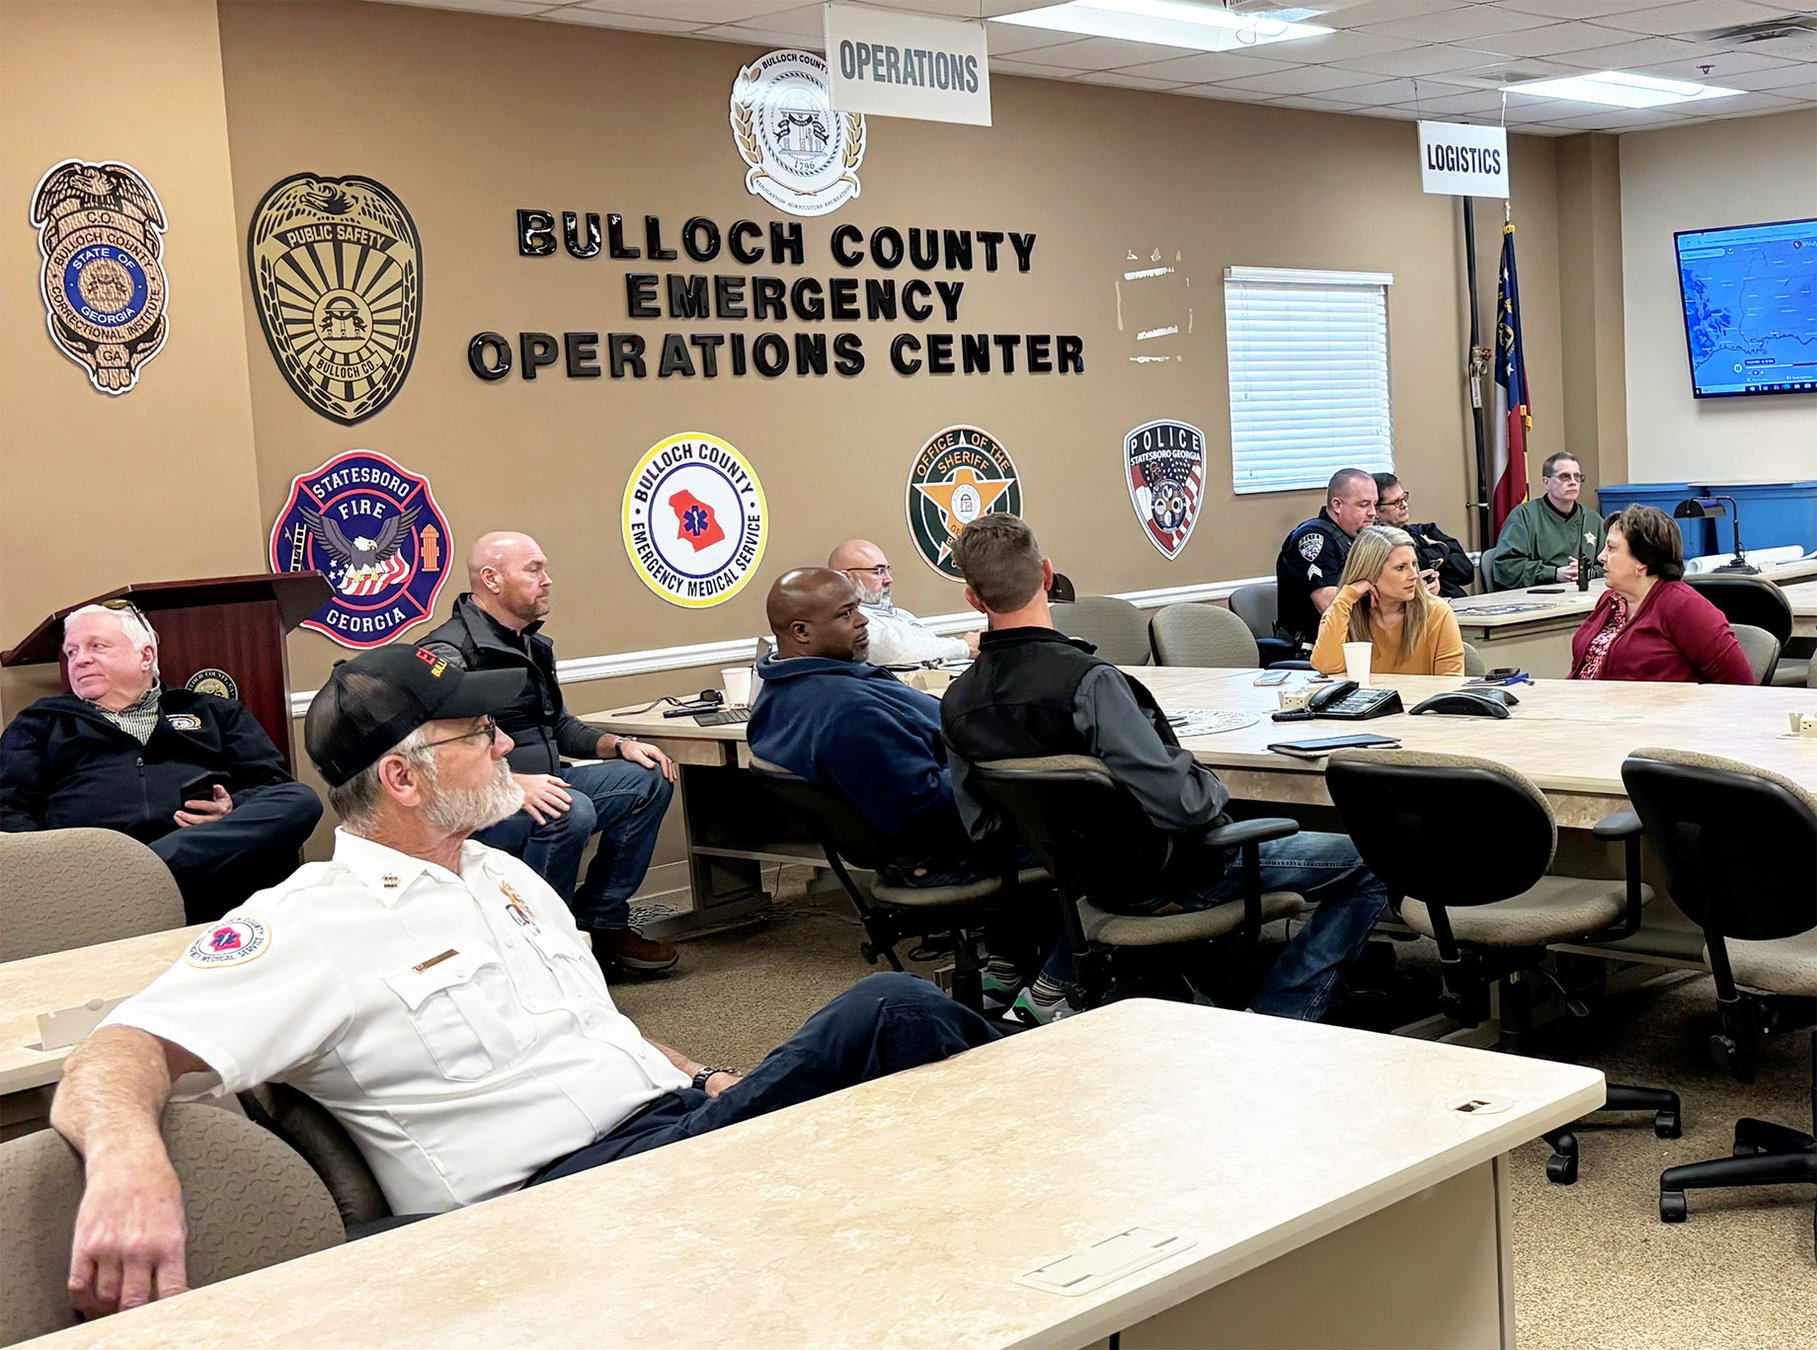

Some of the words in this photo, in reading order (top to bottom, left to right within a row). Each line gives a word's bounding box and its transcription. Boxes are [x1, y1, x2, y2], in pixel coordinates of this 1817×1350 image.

[762, 53, 797, 70] BULLOCH
[839, 39, 979, 93] OPERATIONS
[794, 160, 816, 172] 1796
[1427, 144, 1501, 175] LOGISTICS
[86, 211, 114, 224] C.O.
[54, 232, 103, 266] BULLOCH
[106, 232, 153, 268] COUNTY
[286, 225, 334, 247] PUBLIC
[336, 225, 386, 249] SAFETY
[516, 208, 805, 265] BULLOCH
[830, 223, 1037, 272] COUNTY
[72, 247, 110, 269] STATE
[117, 253, 136, 269] OF
[624, 272, 965, 322] EMERGENCY
[51, 286, 125, 340] CORRECTIONAL
[127, 288, 161, 338] INSTITUTE
[80, 306, 136, 324] GEORGIA
[102, 350, 123, 362] GA
[316, 358, 360, 378] BULLOCH
[362, 360, 379, 376] CO.
[467, 331, 866, 380] OPERATIONS
[890, 333, 1085, 376] CENTER
[916, 433, 955, 477] OFFICE
[971, 432, 989, 447] OF
[991, 445, 1010, 472] THE
[1130, 427, 1200, 455] POLICE
[937, 451, 990, 474] SHERIFF
[1130, 449, 1171, 467] STATESBORO
[1172, 449, 1201, 462] GEORGIA
[312, 467, 410, 499] STATESBORO
[634, 443, 693, 504] BULLOCH
[698, 443, 754, 496] COUNTY
[337, 499, 386, 520] FIRE
[631, 522, 685, 594] EMERGENCY
[687, 568, 739, 597] MEDICAL
[735, 514, 761, 571] SERVICE
[326, 607, 407, 633] GEORGIA
